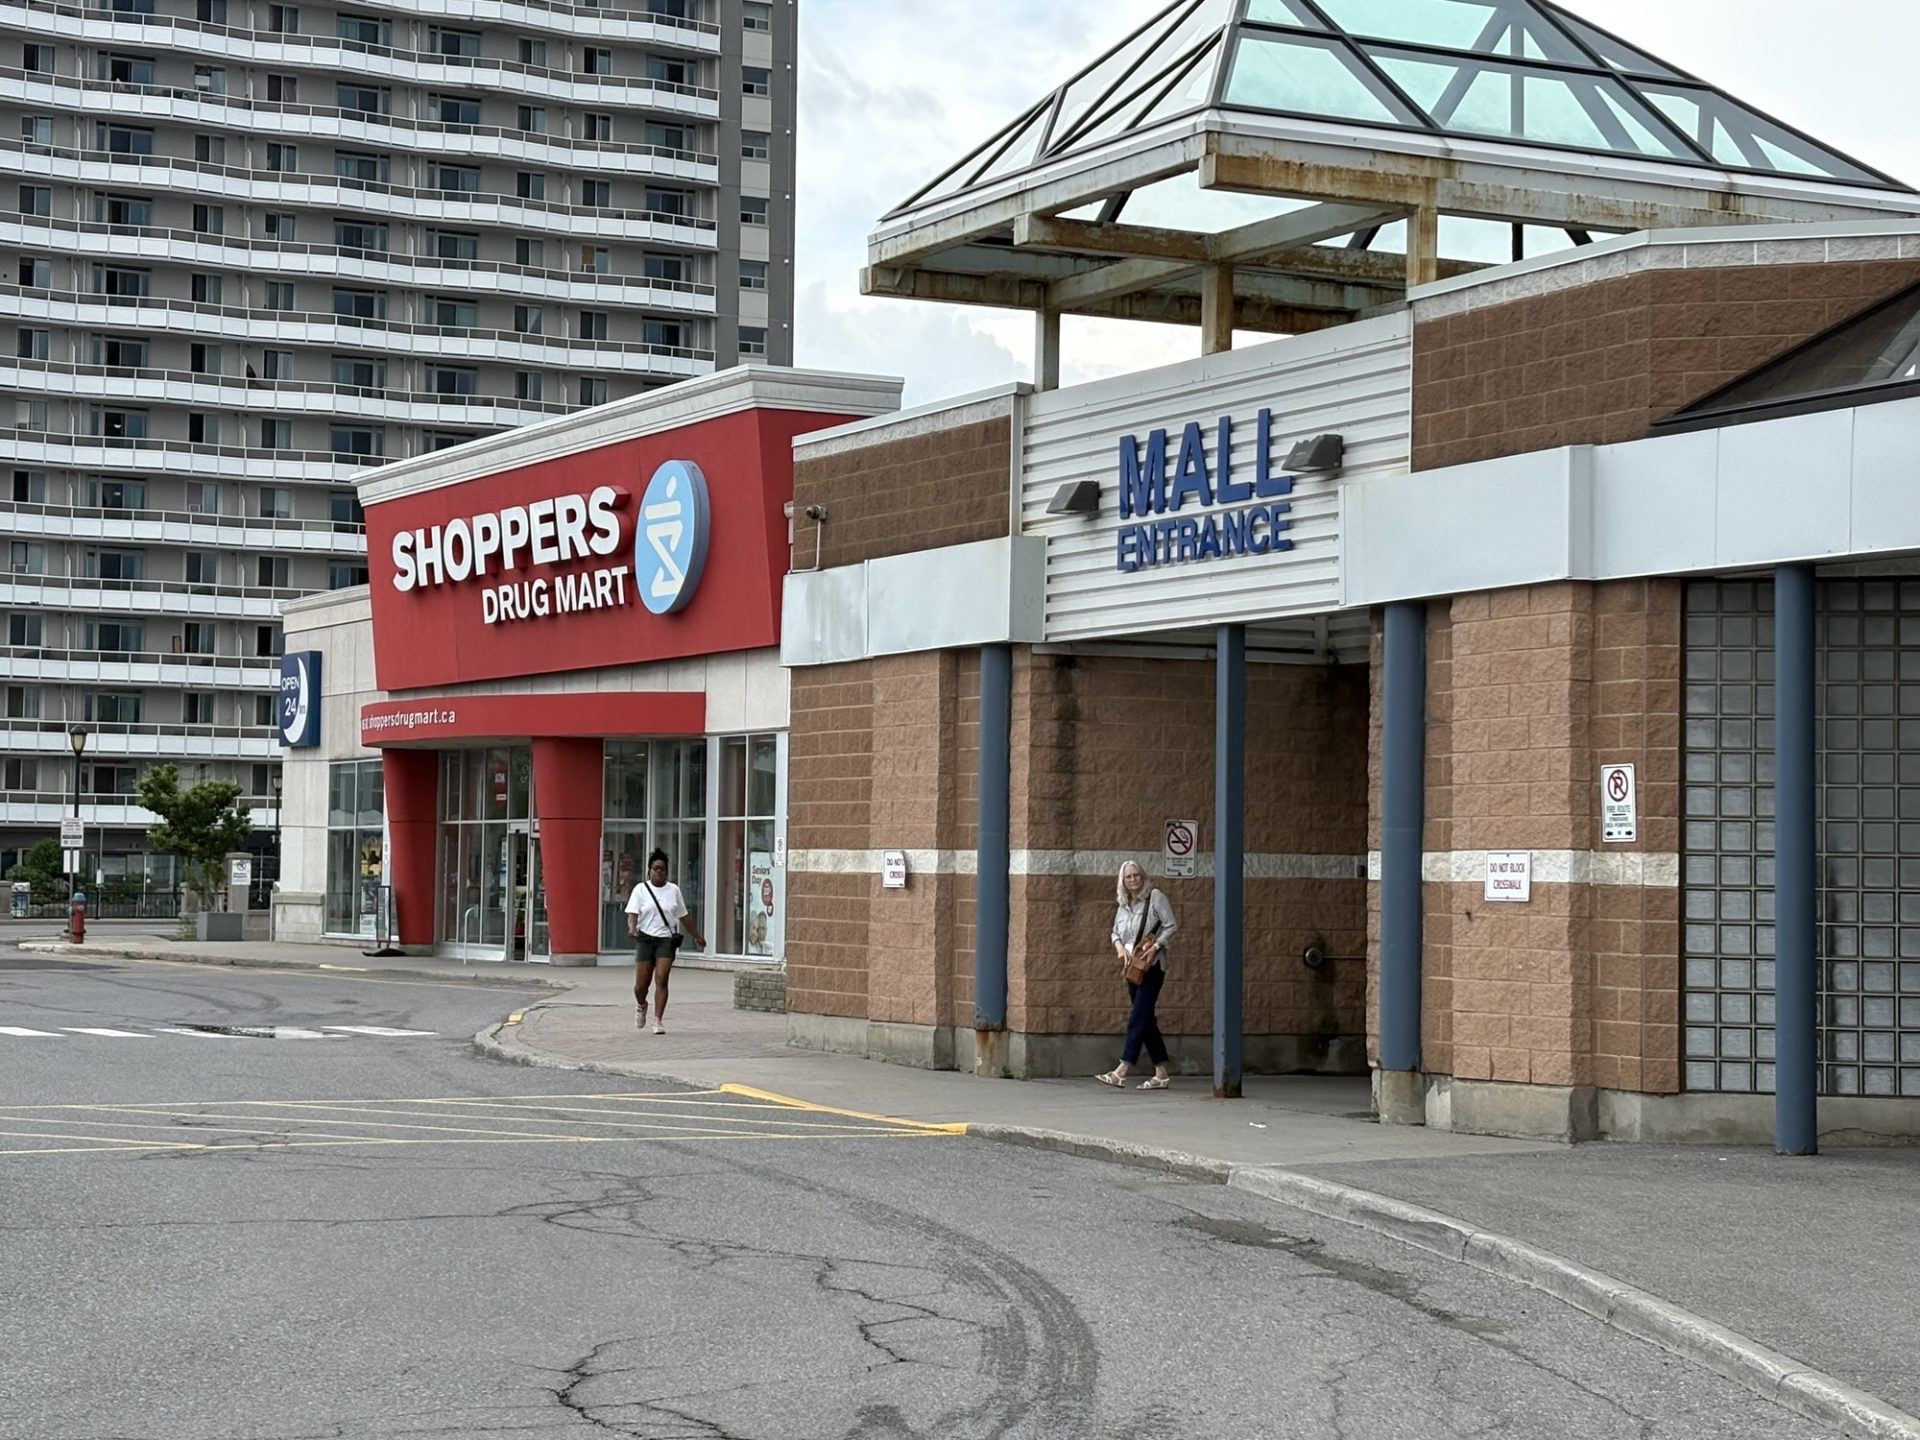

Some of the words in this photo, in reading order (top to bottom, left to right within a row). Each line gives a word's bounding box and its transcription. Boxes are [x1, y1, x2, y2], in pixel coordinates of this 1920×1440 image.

[1119, 408, 1293, 520] MALL
[391, 486, 623, 592] SHOPPERS
[1117, 503, 1294, 572] ENTRANCE
[482, 577, 550, 625] DRUG
[555, 566, 628, 615] MART
[281, 676, 299, 691] OPEN
[284, 697, 297, 717] 24
[1490, 863, 1497, 873] DO
[1499, 863, 1509, 873] NOT
[1510, 863, 1525, 873] BLOCK
[1493, 879, 1522, 890] CROSSWALK
